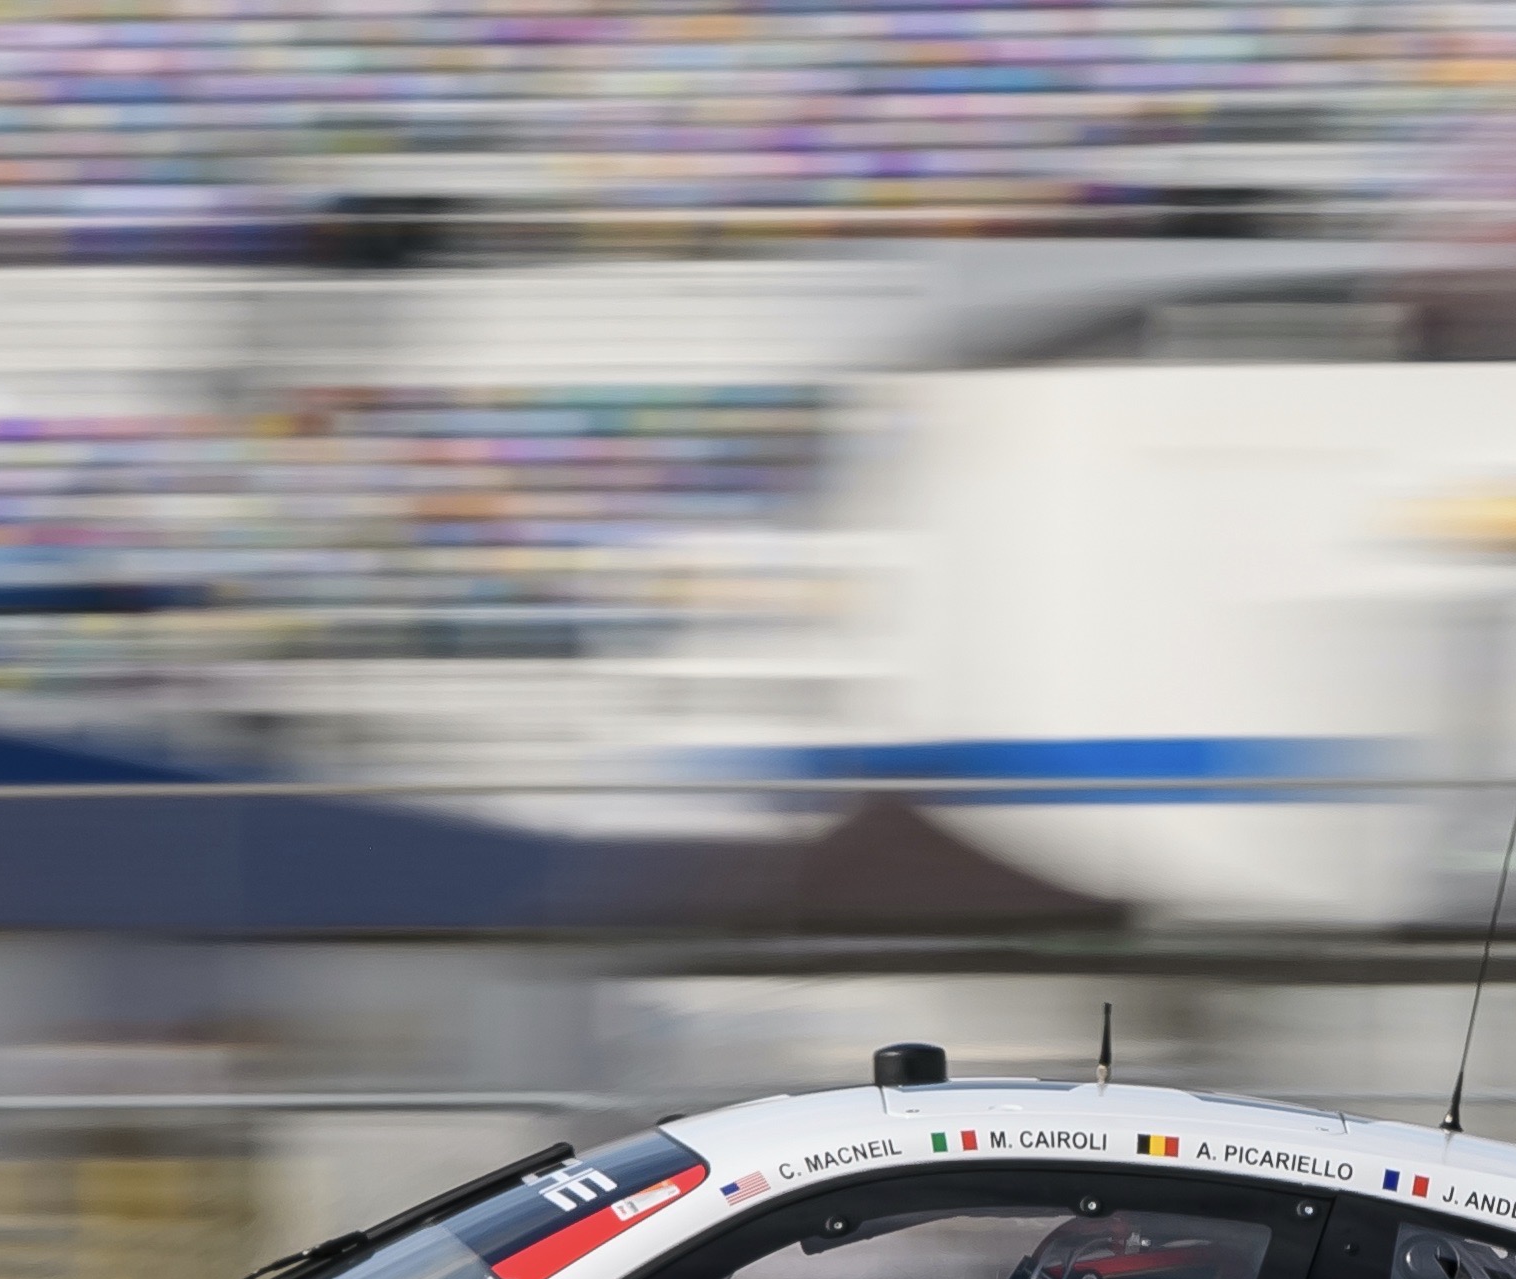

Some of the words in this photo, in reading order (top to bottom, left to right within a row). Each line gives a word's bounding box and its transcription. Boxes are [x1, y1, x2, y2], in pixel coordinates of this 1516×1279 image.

[989, 1130, 1013, 1149] M.
[1019, 1130, 1108, 1151] CAIROLI
[778, 1162, 802, 1181] C.
[804, 1138, 903, 1173] MACNEIL
[1195, 1142, 1218, 1161] A.
[1223, 1145, 1354, 1181] PICARIELLO
[1441, 1186, 1460, 1206] J.
